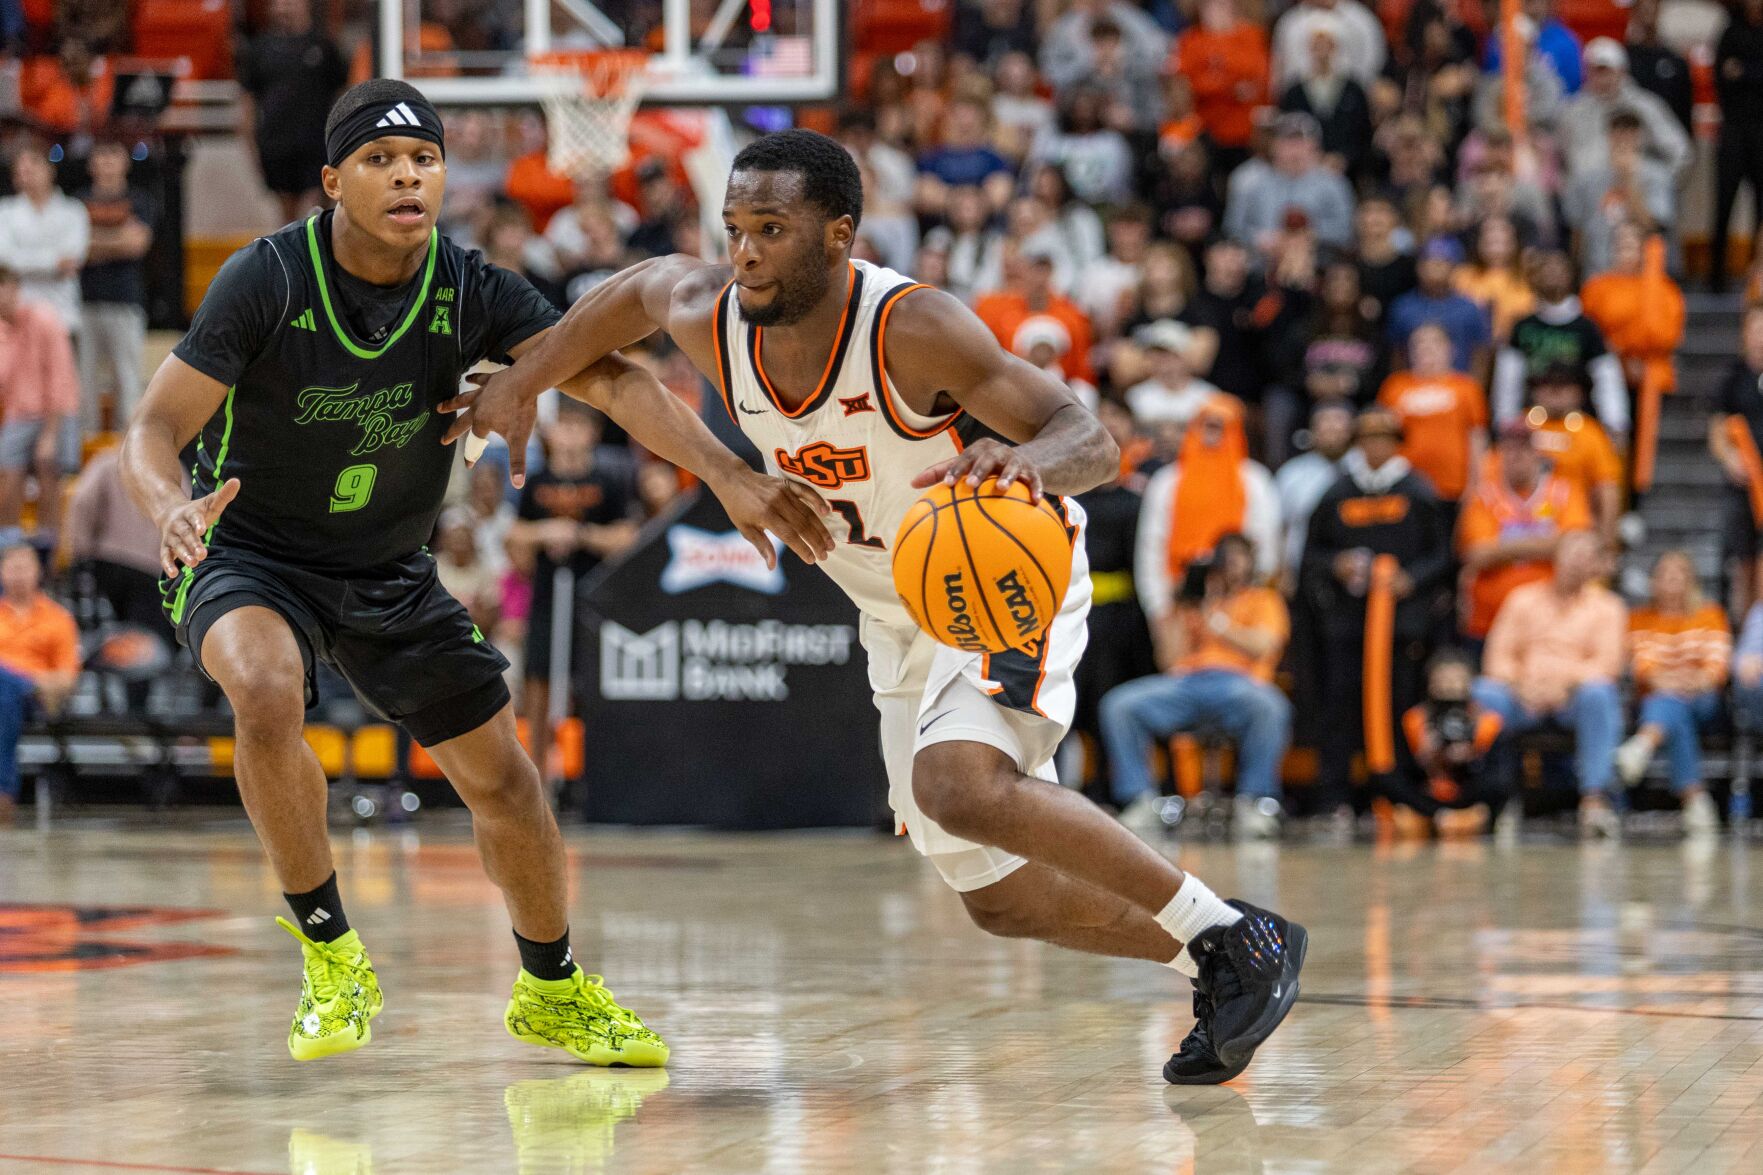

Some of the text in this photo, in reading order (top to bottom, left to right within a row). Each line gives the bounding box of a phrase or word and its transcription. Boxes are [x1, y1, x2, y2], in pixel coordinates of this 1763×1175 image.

[435, 287, 455, 301] AAR
[294, 382, 413, 425] Tampa
[351, 407, 431, 456] Bay
[329, 463, 378, 513] 9
[996, 569, 1040, 637] NCAA
